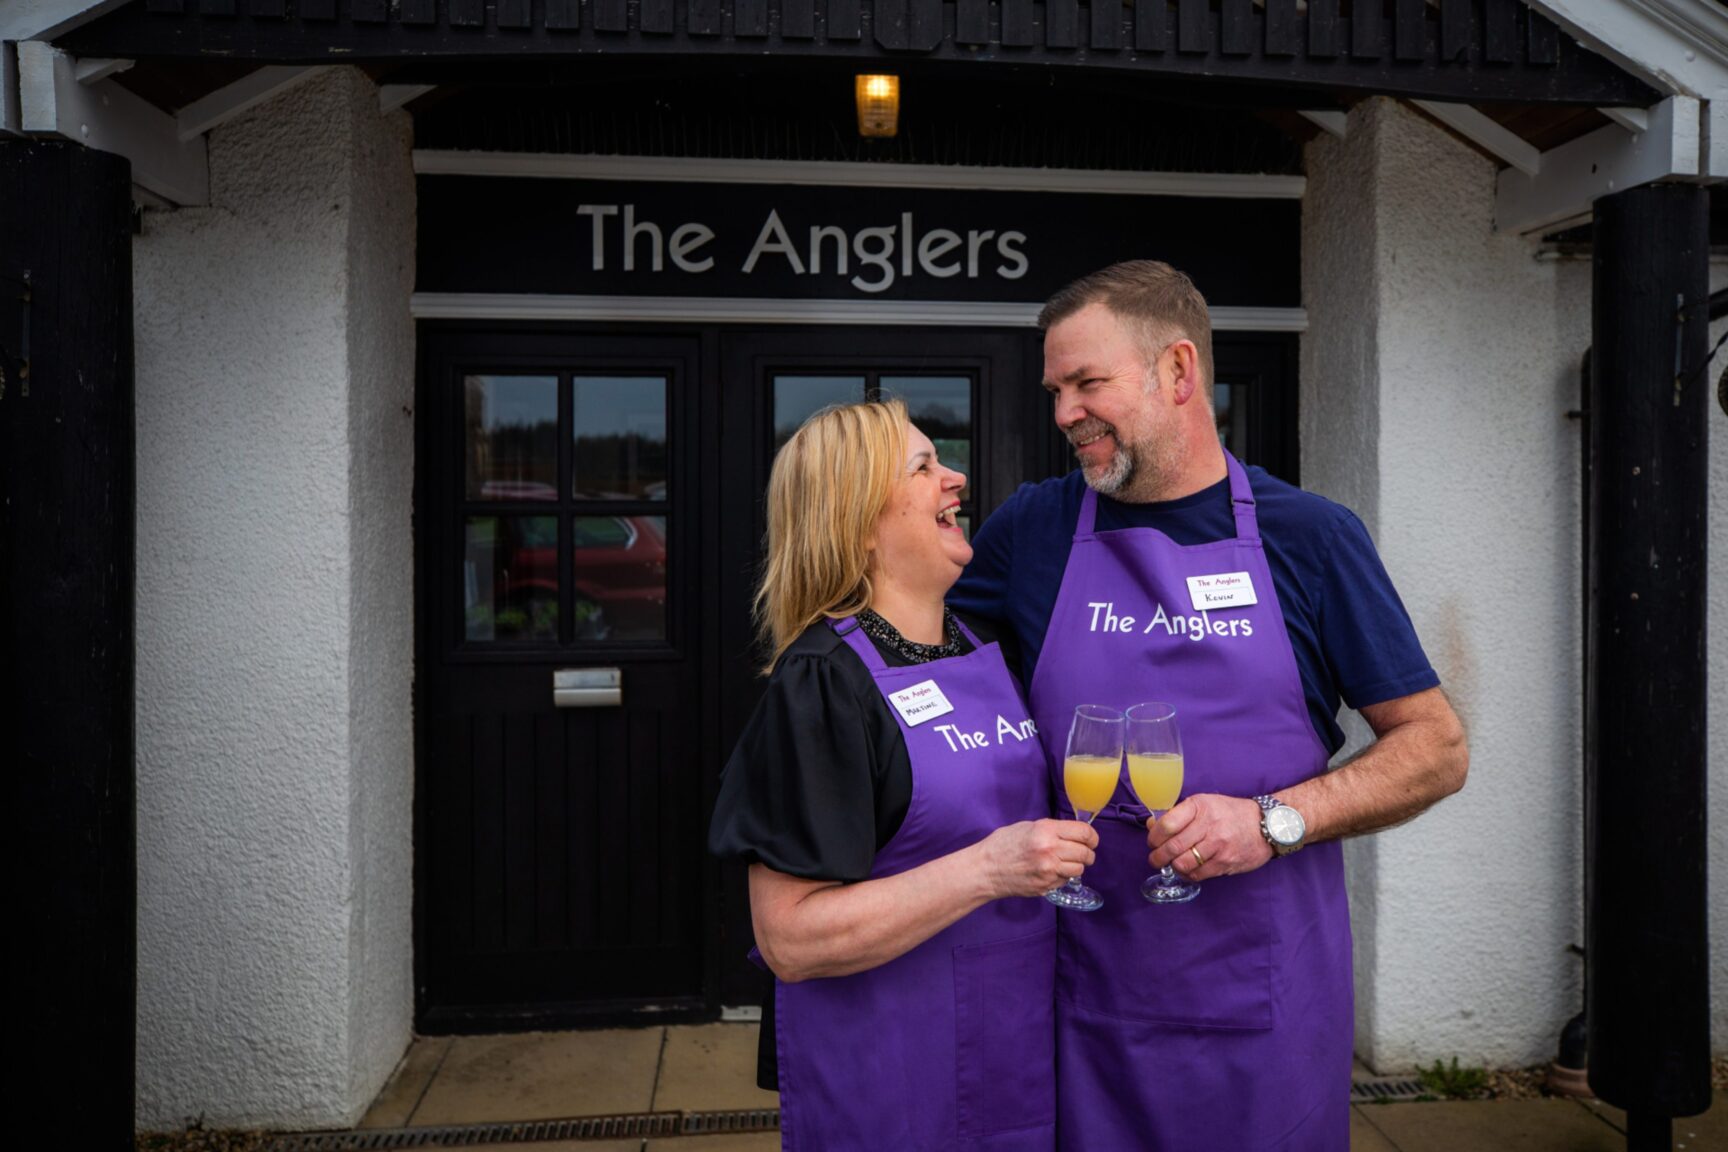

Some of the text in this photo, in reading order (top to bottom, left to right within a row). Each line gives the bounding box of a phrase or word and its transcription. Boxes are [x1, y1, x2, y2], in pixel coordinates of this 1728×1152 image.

[576, 203, 1030, 293] The Anglers
[1088, 602, 1253, 641] The Anglers
[933, 723, 990, 752] The
